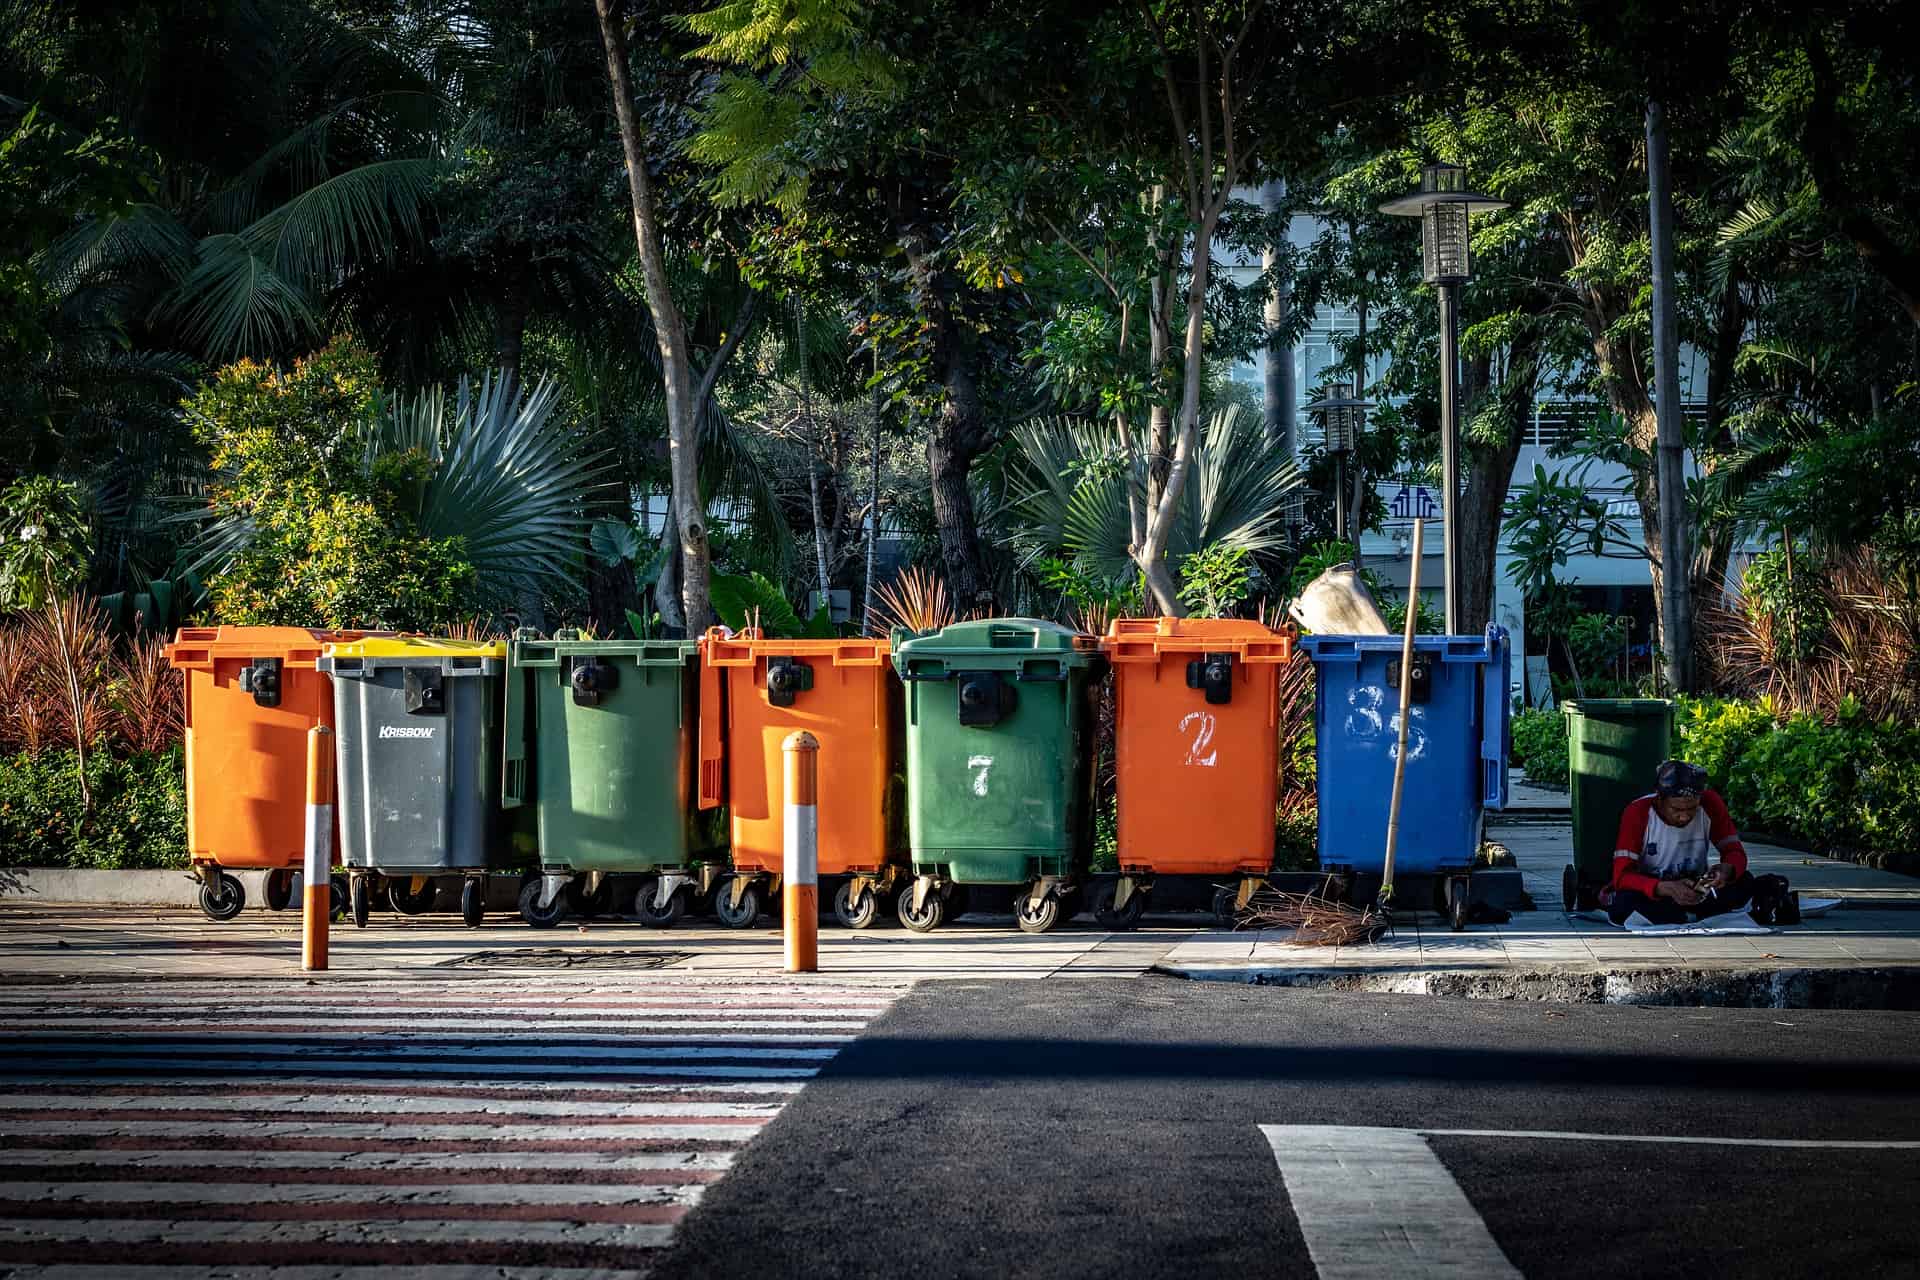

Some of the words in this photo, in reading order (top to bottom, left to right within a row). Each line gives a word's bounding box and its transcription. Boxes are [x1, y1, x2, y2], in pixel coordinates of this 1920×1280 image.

[379, 726, 434, 739] KRISBOW
[1179, 711, 1217, 767] 2
[967, 755, 994, 797] 7
